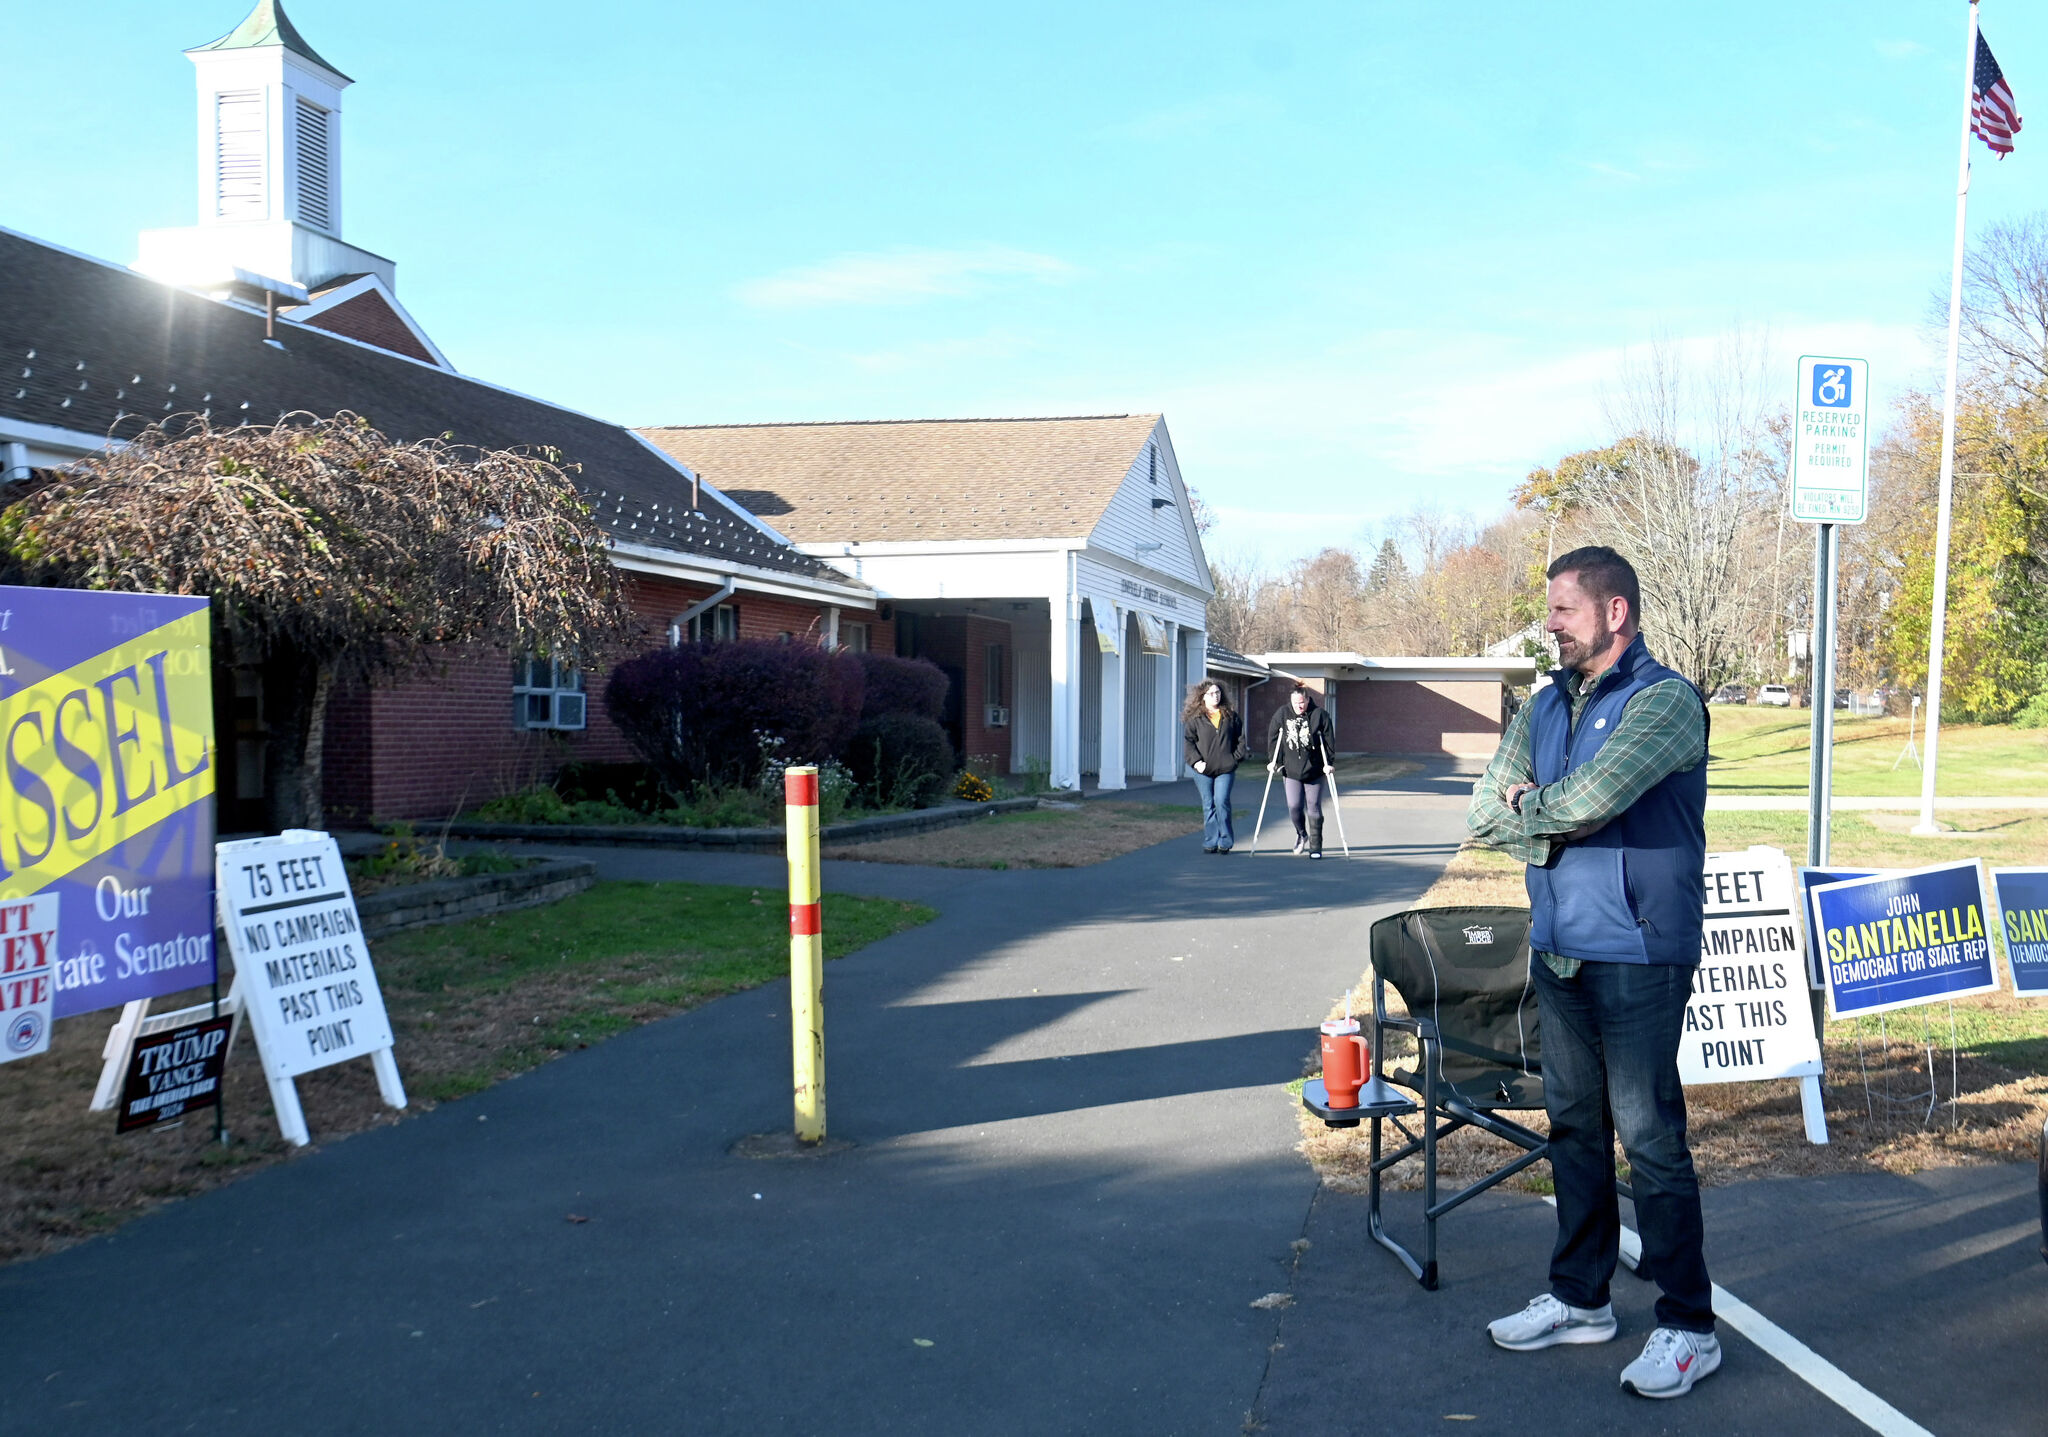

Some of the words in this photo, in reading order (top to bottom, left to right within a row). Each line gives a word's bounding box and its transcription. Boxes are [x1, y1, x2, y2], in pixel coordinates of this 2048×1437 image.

[1802, 410, 1860, 425] RESERVED
[1805, 424, 1857, 438] PARKING
[1808, 455, 1852, 468] REQUIRED
[1814, 443, 1846, 455] PERMIT
[1803, 492, 1837, 503] VIOLATORS
[0, 649, 209, 882] SSEL
[242, 863, 273, 898] 75
[277, 856, 326, 893] FEET
[1703, 871, 1764, 905] FEET
[96, 875, 152, 921] Our
[1886, 893, 1921, 917] JOHN
[244, 924, 271, 954] NO
[274, 907, 357, 947] CAMPAIGN
[1701, 926, 1795, 956] AMPAIGN
[1827, 904, 1984, 963] SANTANELLA
[2005, 909, 2048, 942] SAN
[55, 951, 105, 991] tate
[115, 933, 210, 979] Senator
[265, 943, 357, 989] MATERIALS
[1832, 955, 1899, 985] DEMOCRAT
[1901, 947, 1926, 973] FOR
[1928, 943, 1961, 968] STATE
[1963, 939, 1987, 962] REP
[2011, 943, 2048, 964] DEMOC
[1692, 963, 1787, 994] TERIALS
[280, 989, 321, 1025] PAST
[323, 979, 363, 1012] THIS
[1686, 1004, 1725, 1032] AST
[1735, 1000, 1787, 1028] THIS
[138, 1029, 226, 1077] TRUMP
[307, 1018, 354, 1057] POINT
[1702, 1039, 1765, 1069] POINT
[149, 1061, 206, 1094] VANCE
